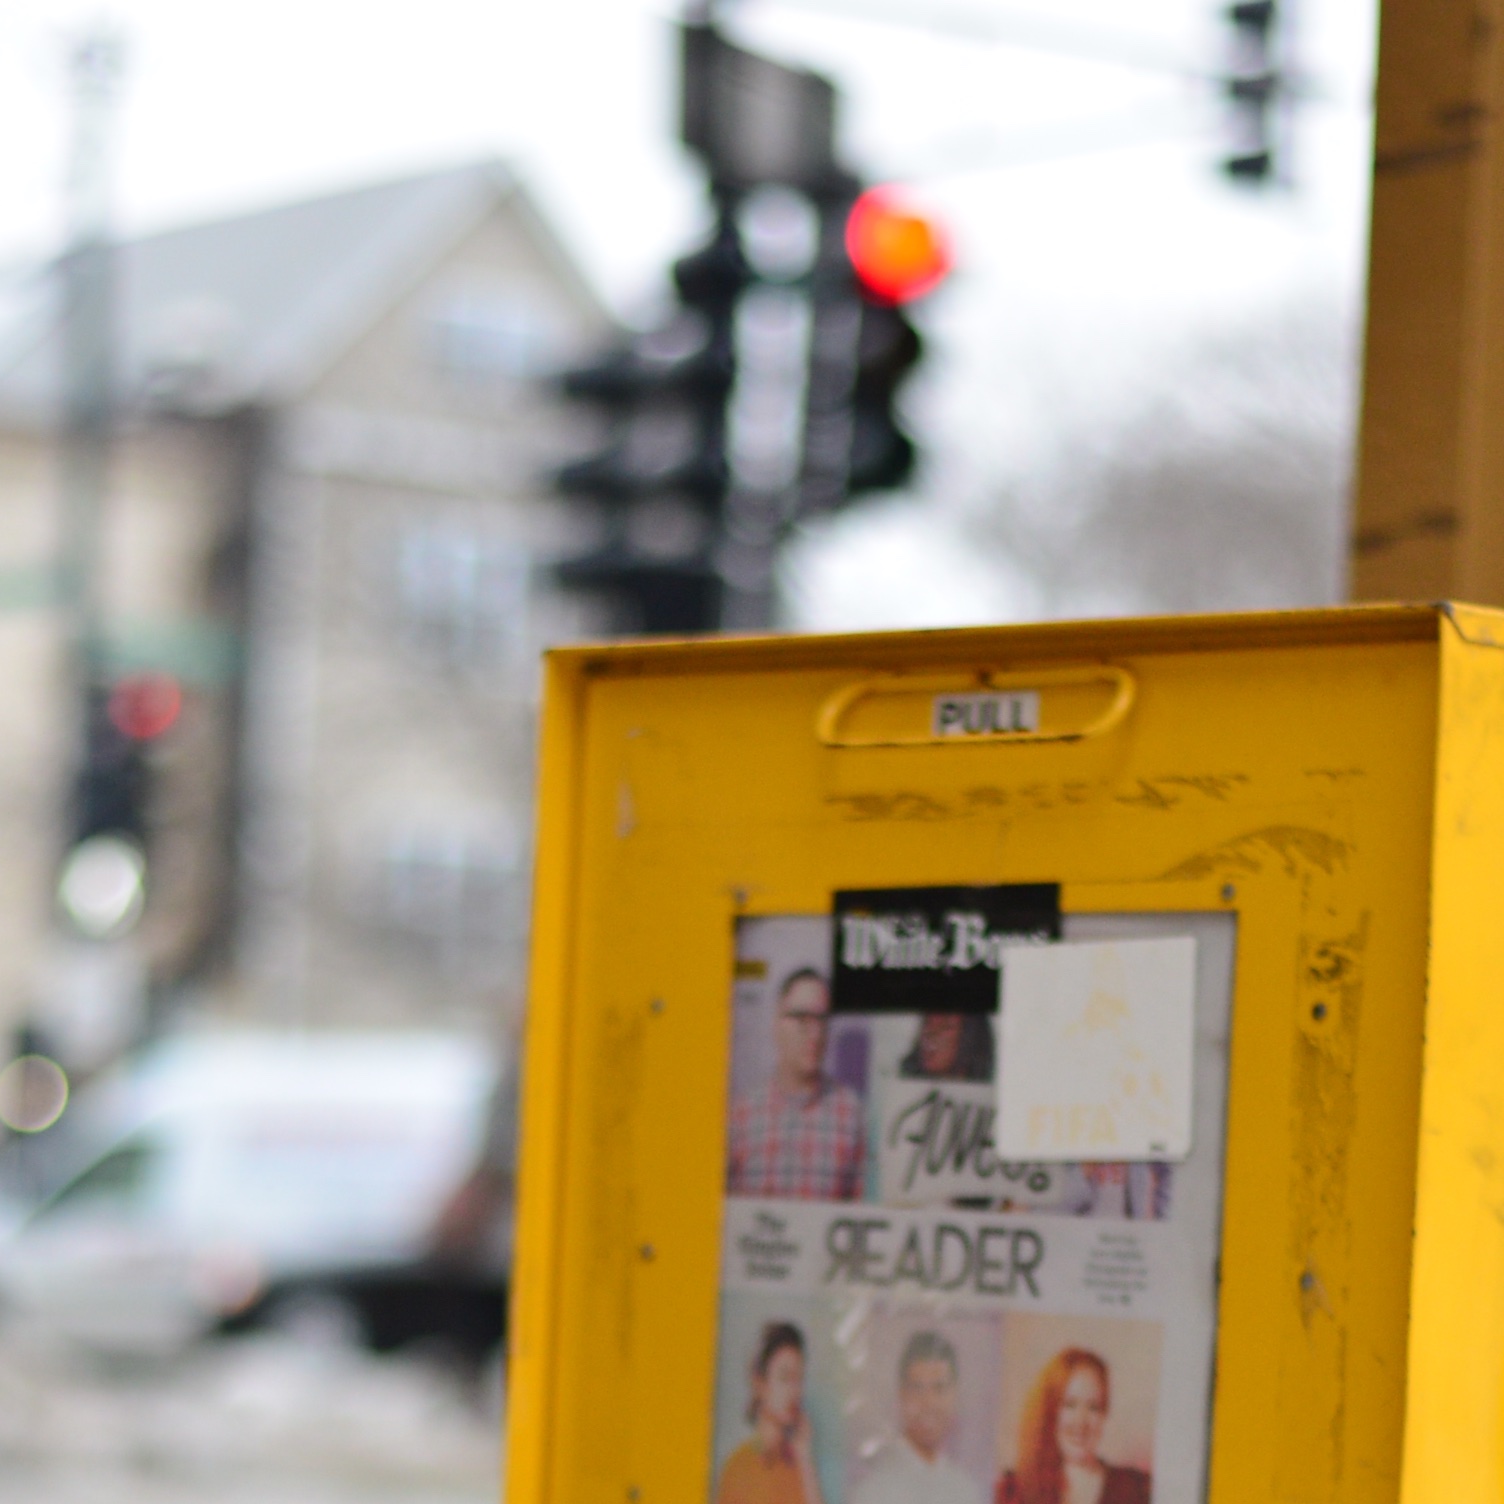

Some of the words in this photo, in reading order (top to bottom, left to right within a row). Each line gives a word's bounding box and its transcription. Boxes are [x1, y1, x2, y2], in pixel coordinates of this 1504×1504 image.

[940, 700, 1032, 737] PULL
[1026, 1102, 1118, 1147] FIFA
[821, 1217, 1045, 1299] READER
